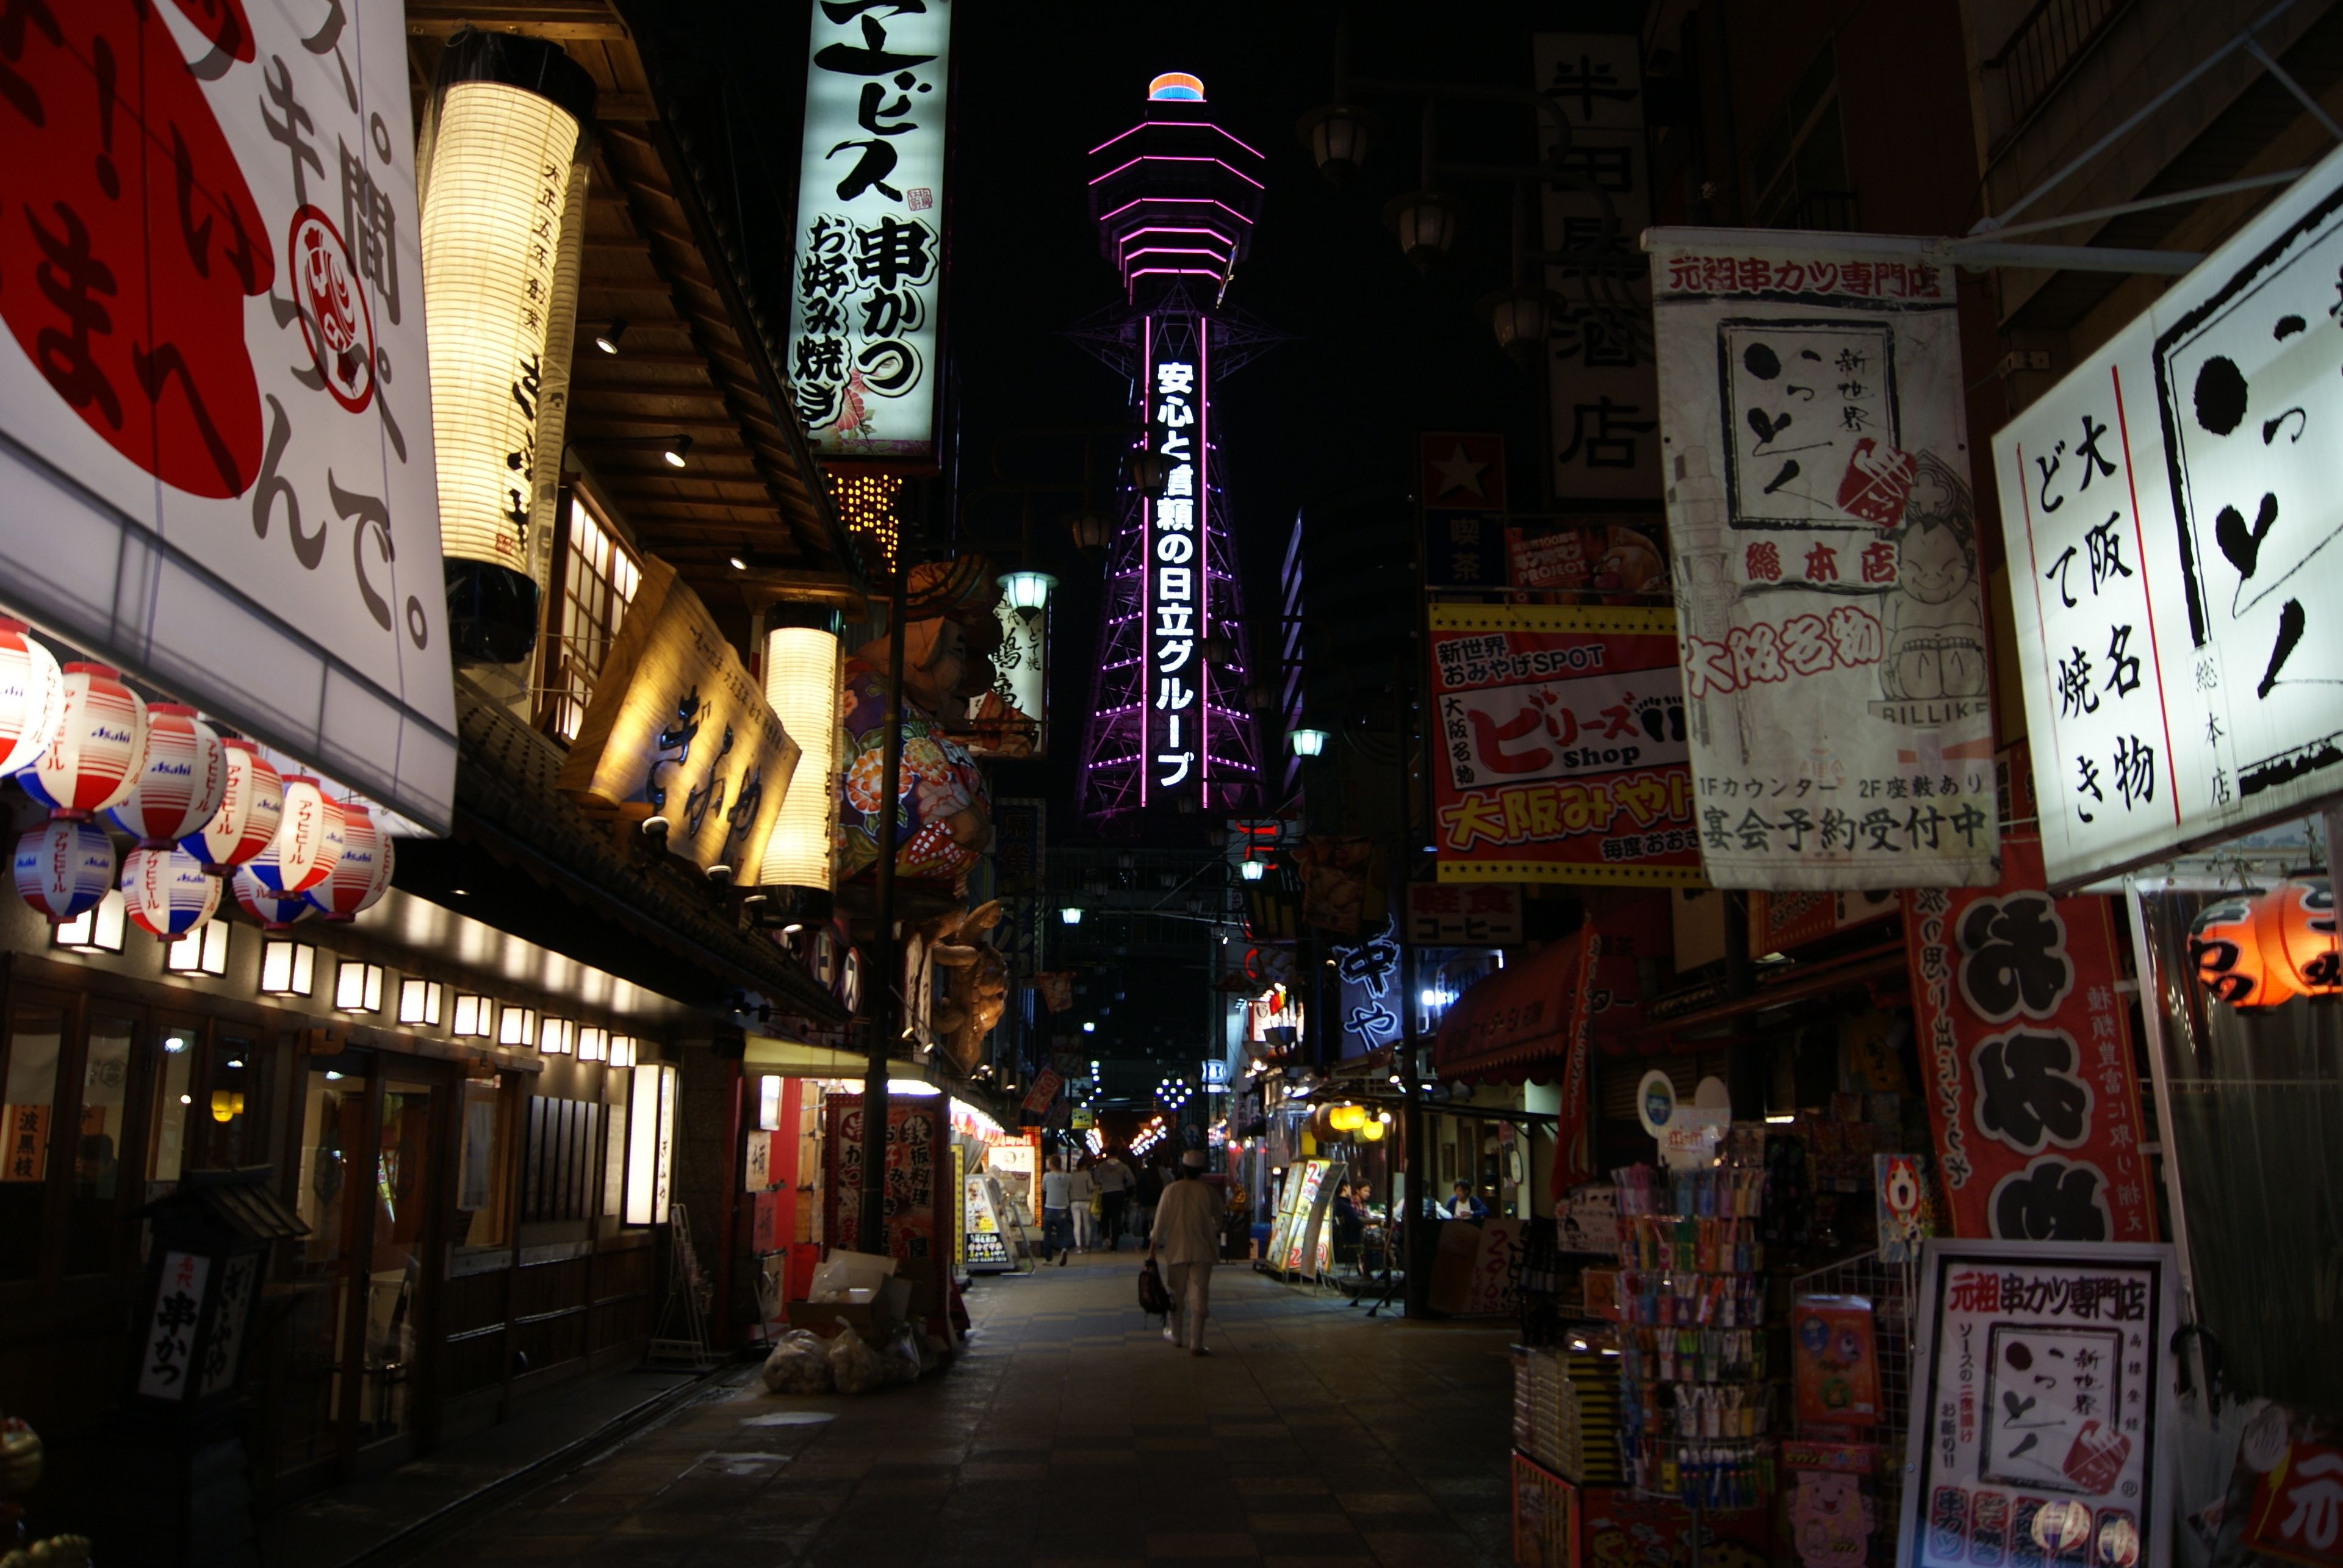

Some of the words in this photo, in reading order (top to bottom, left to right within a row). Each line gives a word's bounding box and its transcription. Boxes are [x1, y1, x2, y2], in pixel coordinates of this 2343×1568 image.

[854, 216, 931, 392] 串かつ
[1669, 256, 1940, 298] 元祖串カツ専門店
[797, 217, 849, 425] お好み焼き
[1156, 362, 1194, 787] 安心と信頼の日立グループ
[1450, 517, 1481, 582] 喫茶
[1518, 559, 1588, 584] PROJECT
[2037, 439, 2104, 823] どて焼き
[2075, 415, 2154, 812] 大阪名物
[1437, 635, 1505, 665] 新世界
[1444, 645, 1605, 687] おみやげSPOT
[1686, 605, 1883, 698] 大阪名物
[90, 725, 131, 744] Asahi
[1445, 696, 1475, 785] 大阪名物
[1467, 688, 1640, 774] ビリーズ
[1563, 744, 1641, 769] Shop
[2195, 656, 2231, 807] 総本店
[151, 761, 192, 776] Asahi
[195, 739, 218, 813] アサヒビール
[1701, 777, 1837, 798] 1Fカウンター
[1860, 773, 1982, 799] 2F座敷あり
[289, 800, 312, 865] アサヒビール
[1703, 803, 1985, 852] 宴会予約受付中
[52, 832, 68, 893] アサヒビール
[176, 874, 206, 883] Asahi
[341, 851, 372, 863] Asahi
[1413, 885, 1514, 915] 軽食
[1417, 917, 1512, 940] コーヒー
[1950, 1271, 2147, 1322] 元祖串カツ専門店
[152, 1290, 196, 1386] 串かつ
